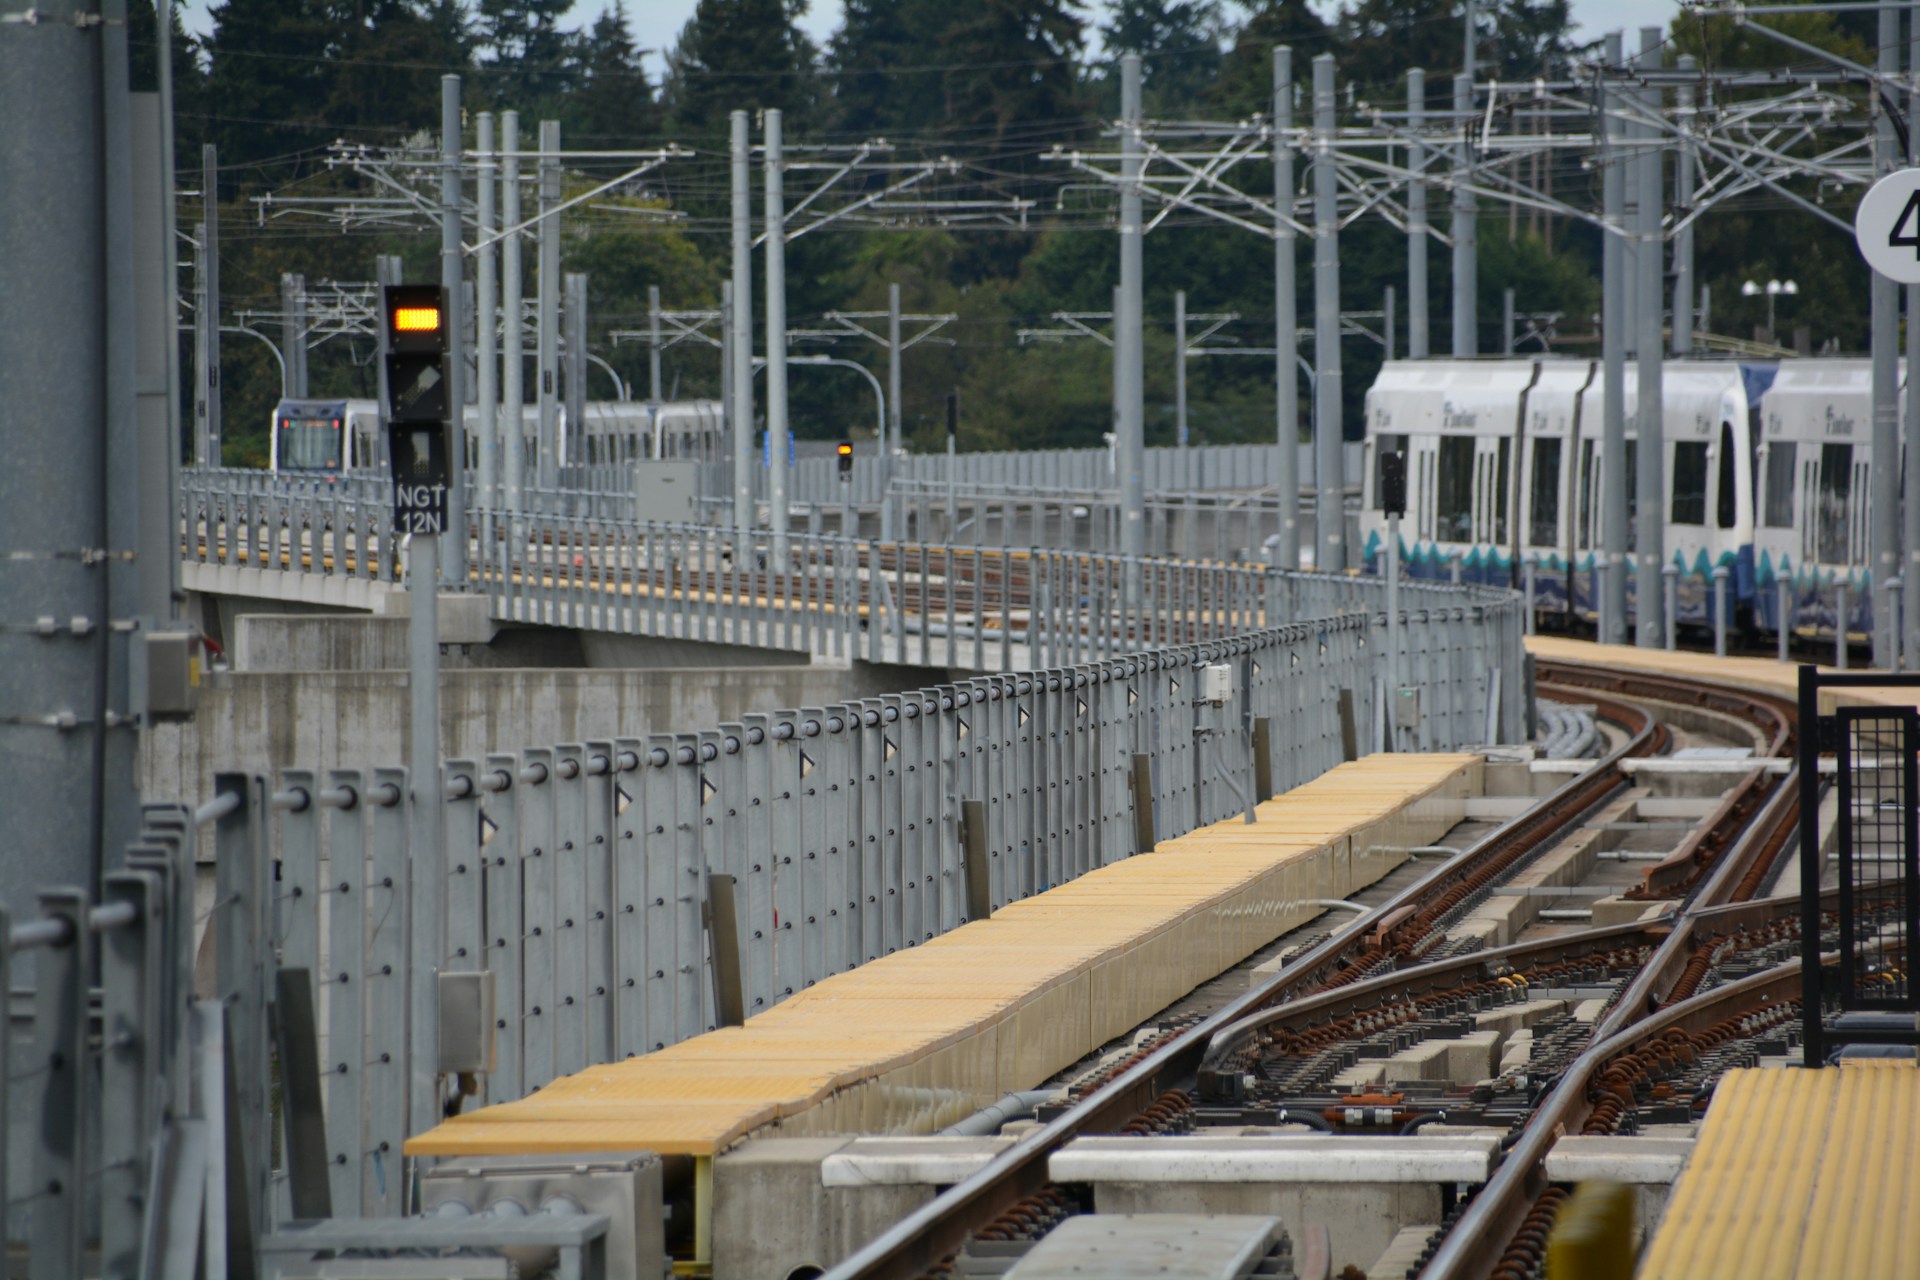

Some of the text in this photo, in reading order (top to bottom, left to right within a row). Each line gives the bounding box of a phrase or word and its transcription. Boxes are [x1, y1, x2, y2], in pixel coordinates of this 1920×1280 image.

[1888, 189, 1920, 262] 4
[397, 485, 446, 508] NGT
[402, 511, 441, 533] 12N
